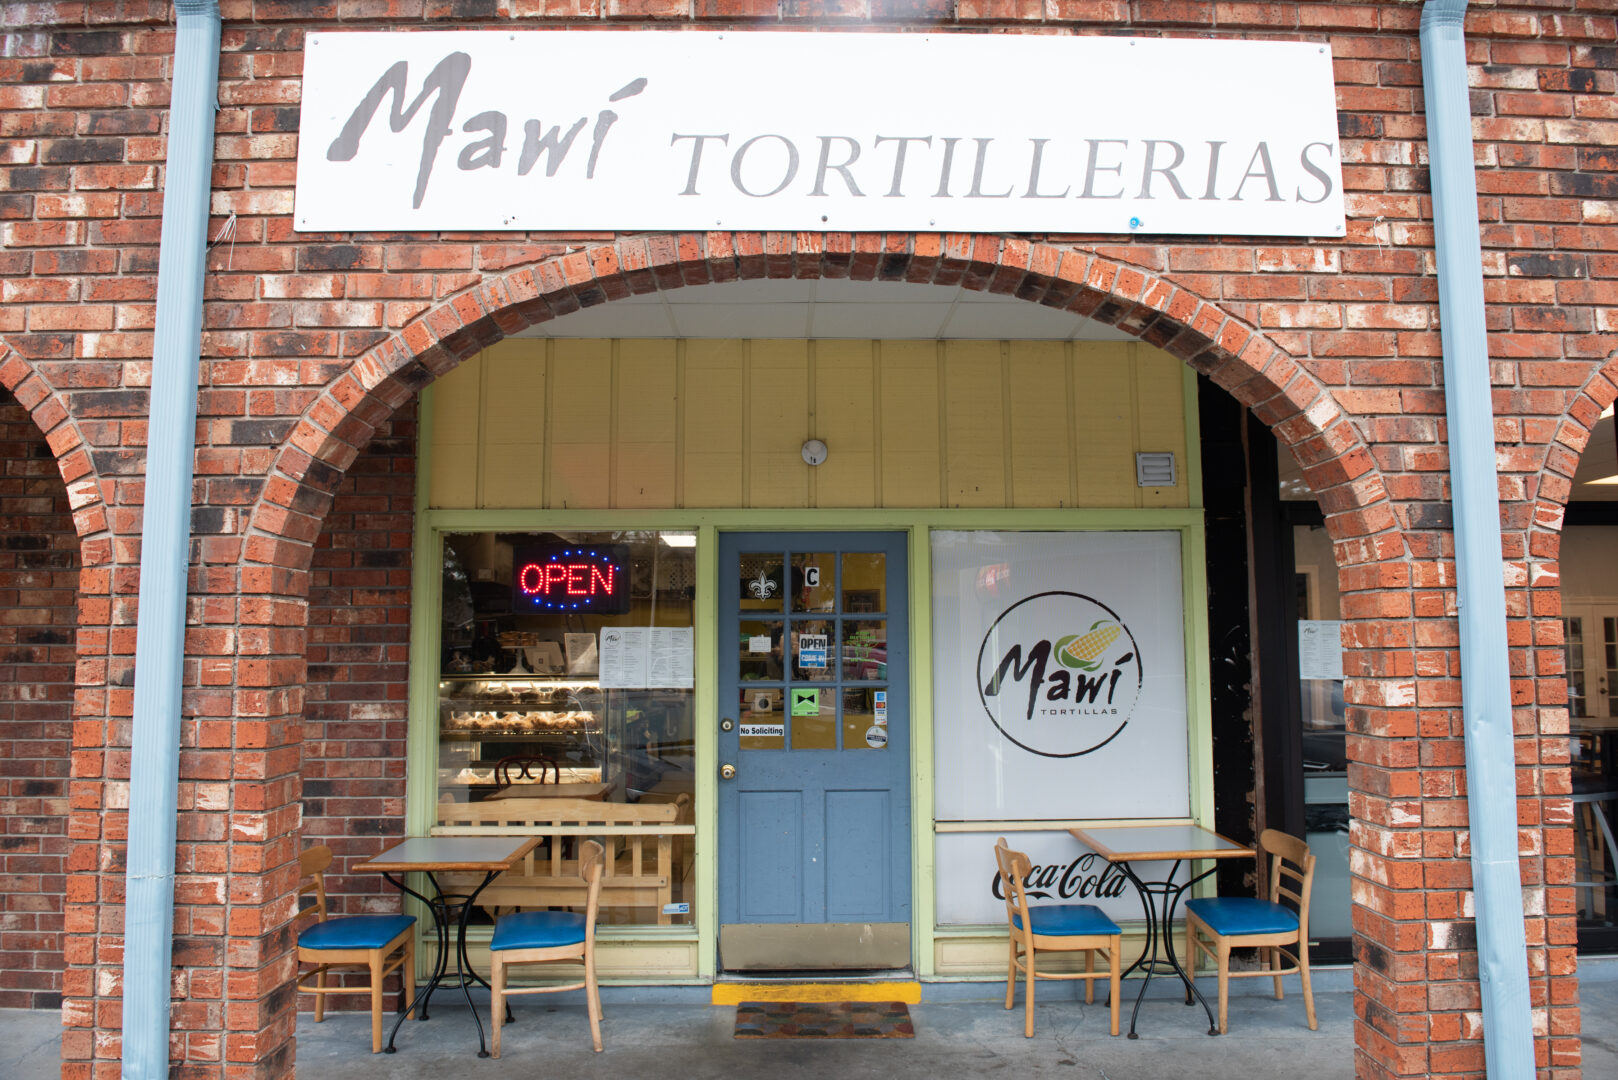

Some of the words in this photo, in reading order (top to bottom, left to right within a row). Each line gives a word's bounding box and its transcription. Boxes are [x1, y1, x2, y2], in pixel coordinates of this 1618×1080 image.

[326, 51, 648, 209] Mawí
[670, 132, 1335, 204] TORTILLERIAS
[520, 564, 614, 595] OPEN
[806, 568, 818, 585] C
[800, 638, 826, 649] OPEN
[985, 640, 1133, 720] Mawí
[1040, 708, 1118, 716] TORTILLAS
[740, 727, 750, 735] No
[751, 727, 783, 736] Soliciting
